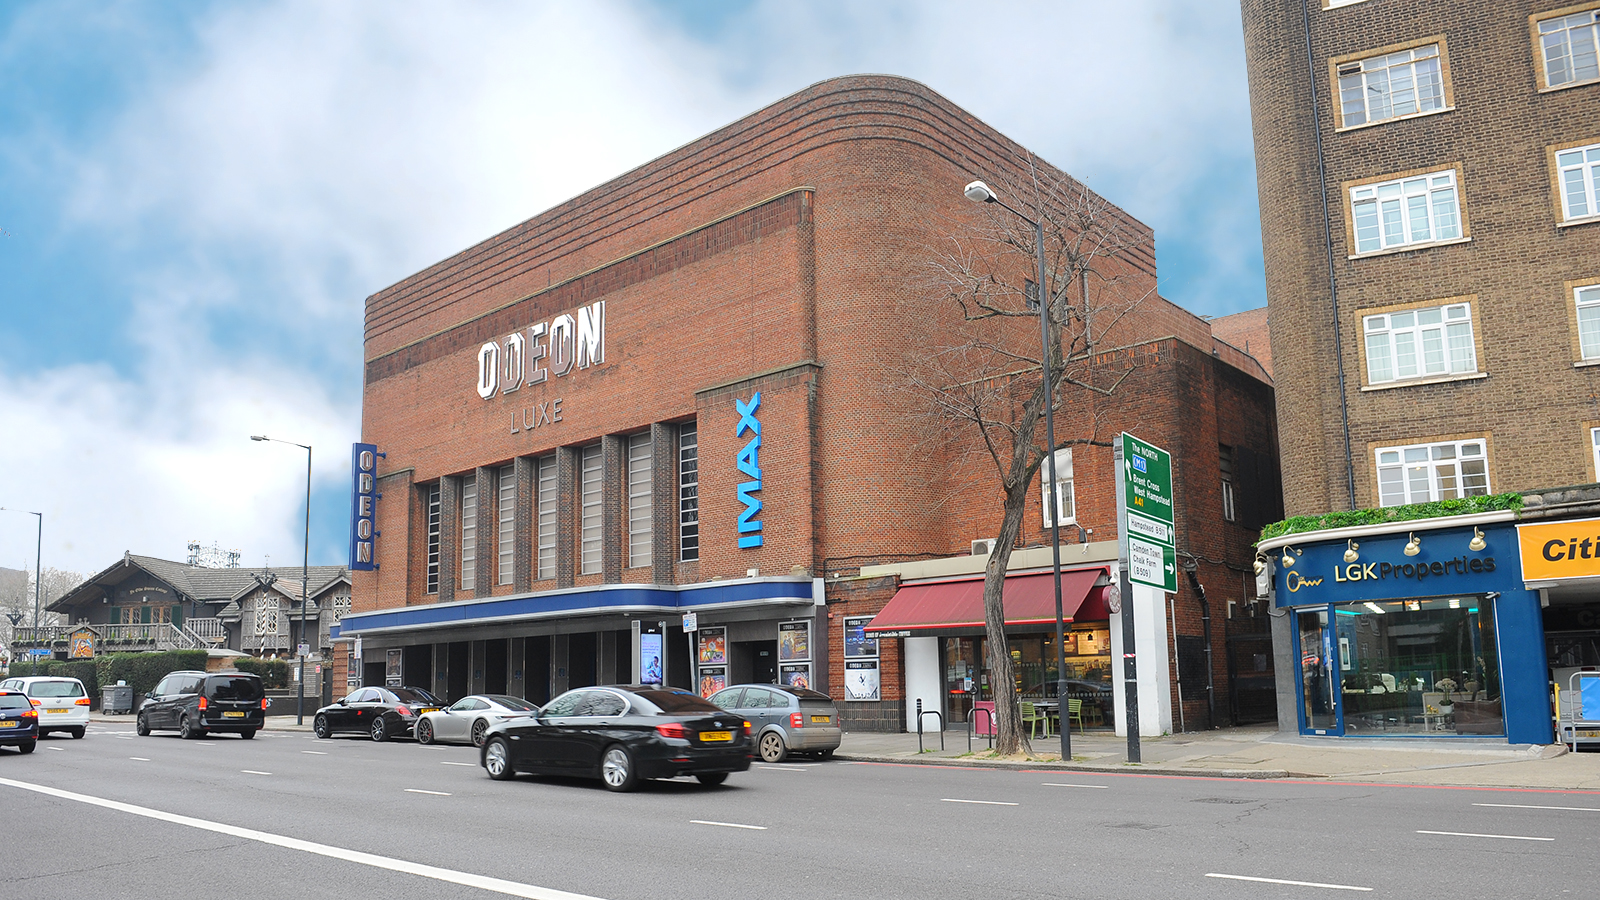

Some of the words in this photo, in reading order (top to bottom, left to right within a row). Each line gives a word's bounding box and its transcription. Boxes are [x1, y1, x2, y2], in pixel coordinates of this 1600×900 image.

[477, 300, 605, 400] ODEON
[510, 398, 563, 434] LUXE
[1132, 442, 1140, 453] The
[1141, 447, 1158, 461] NORTH
[736, 391, 763, 549] IMAX
[1133, 474, 1146, 486] Brent
[1147, 480, 1160, 492] Cross
[1134, 485, 1145, 497] West
[1147, 490, 1170, 506] Hampstead
[1134, 496, 1144, 507] A41
[357, 451, 373, 563] ODEON
[1131, 518, 1154, 532] Hampstead
[1132, 543, 1149, 555] Camden
[1150, 548, 1160, 558] Town
[1133, 554, 1145, 564] Chalk
[1146, 557, 1157, 567] Farm
[1334, 562, 1378, 582] LGK
[1379, 556, 1496, 581] Properties
